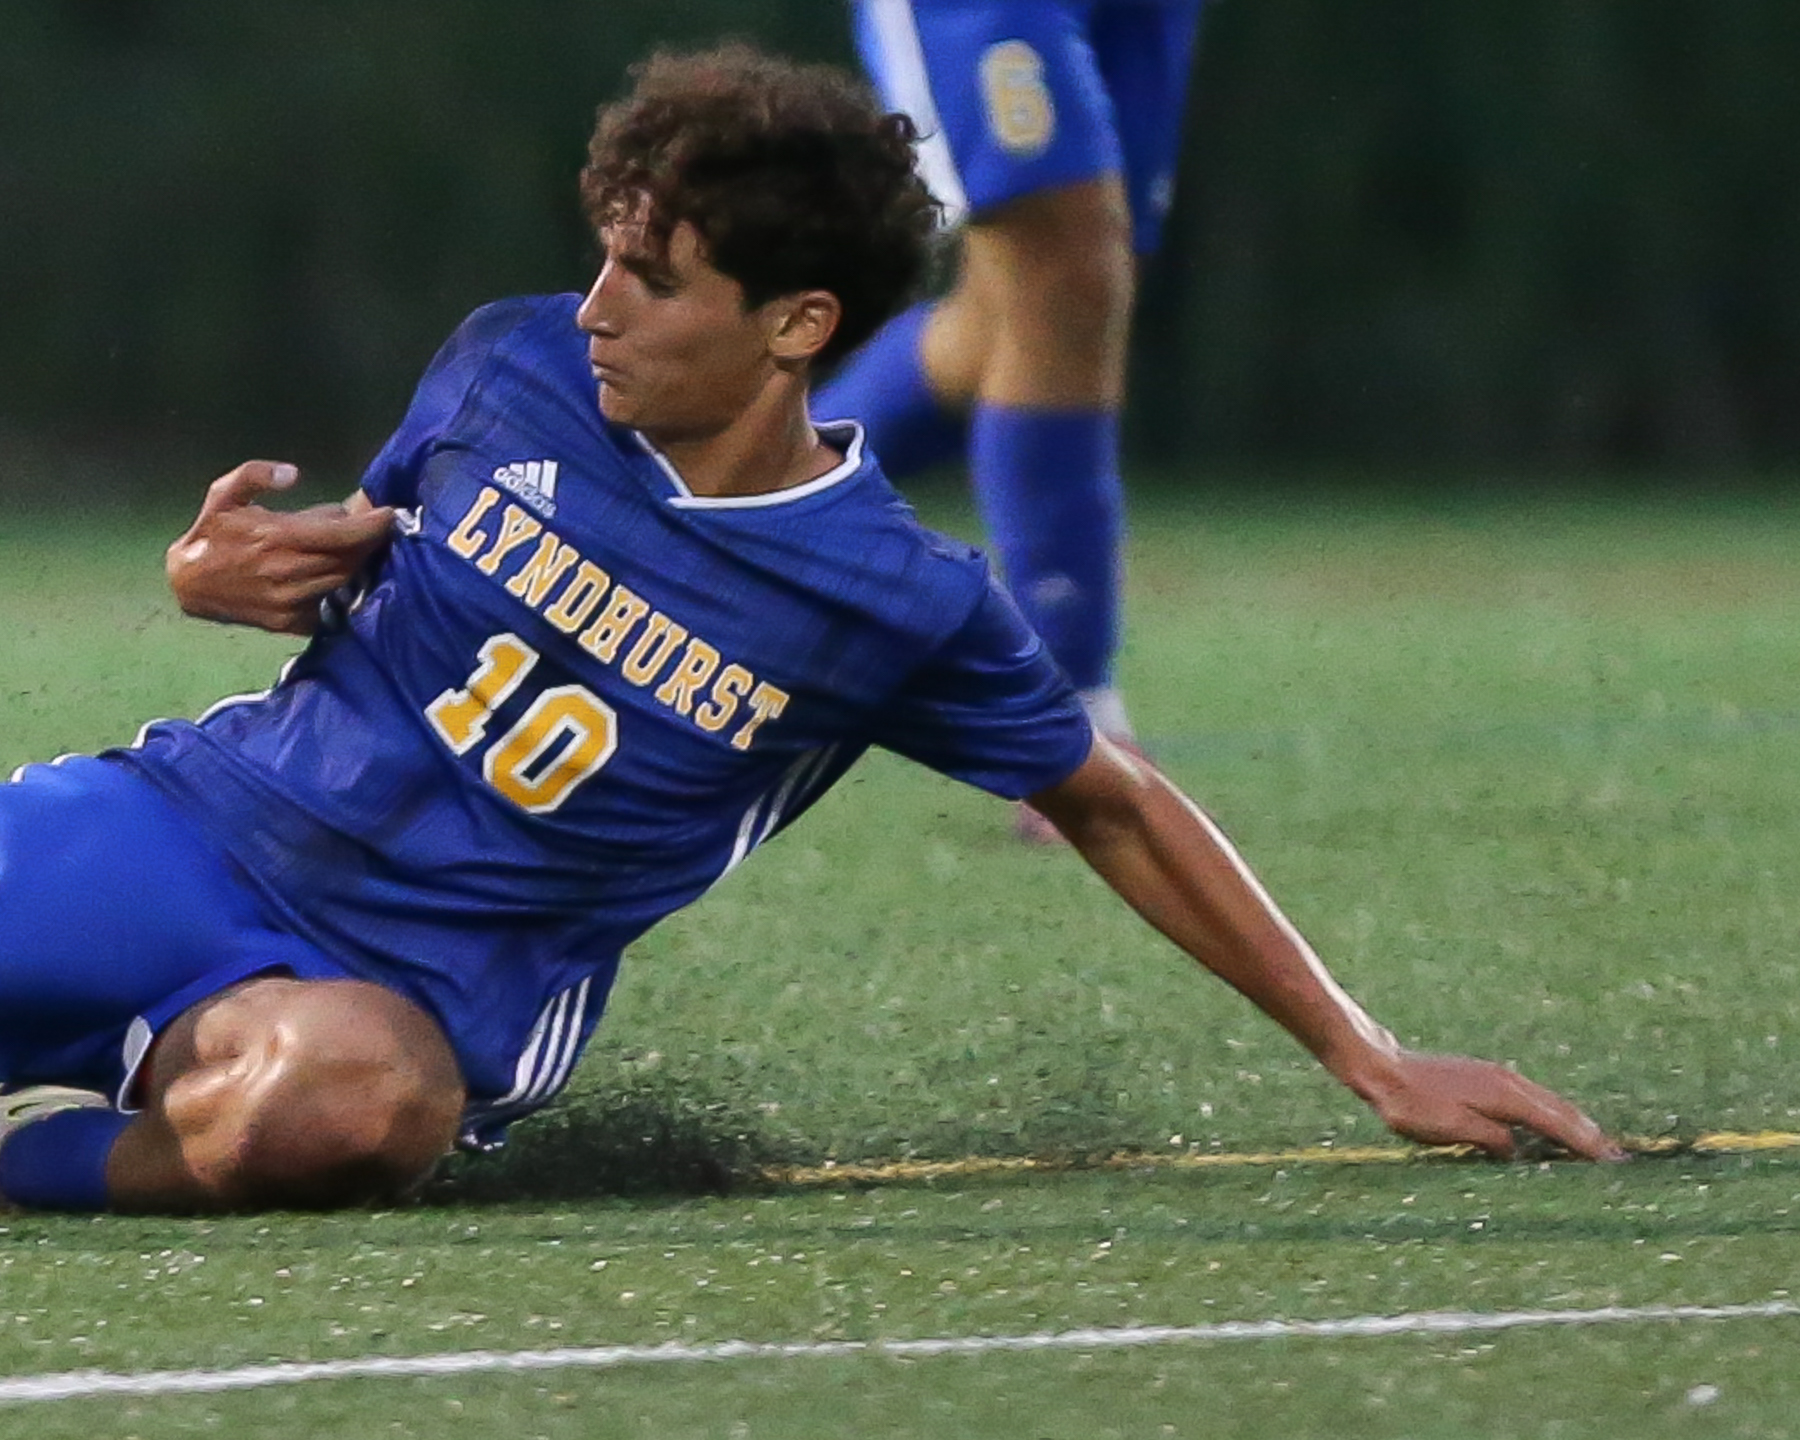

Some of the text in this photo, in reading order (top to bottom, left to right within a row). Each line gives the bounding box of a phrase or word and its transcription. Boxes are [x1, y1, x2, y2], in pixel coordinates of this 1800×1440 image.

[978, 39, 1055, 152] 6
[447, 486, 790, 751] LYNDHURST
[423, 633, 618, 814] 10
